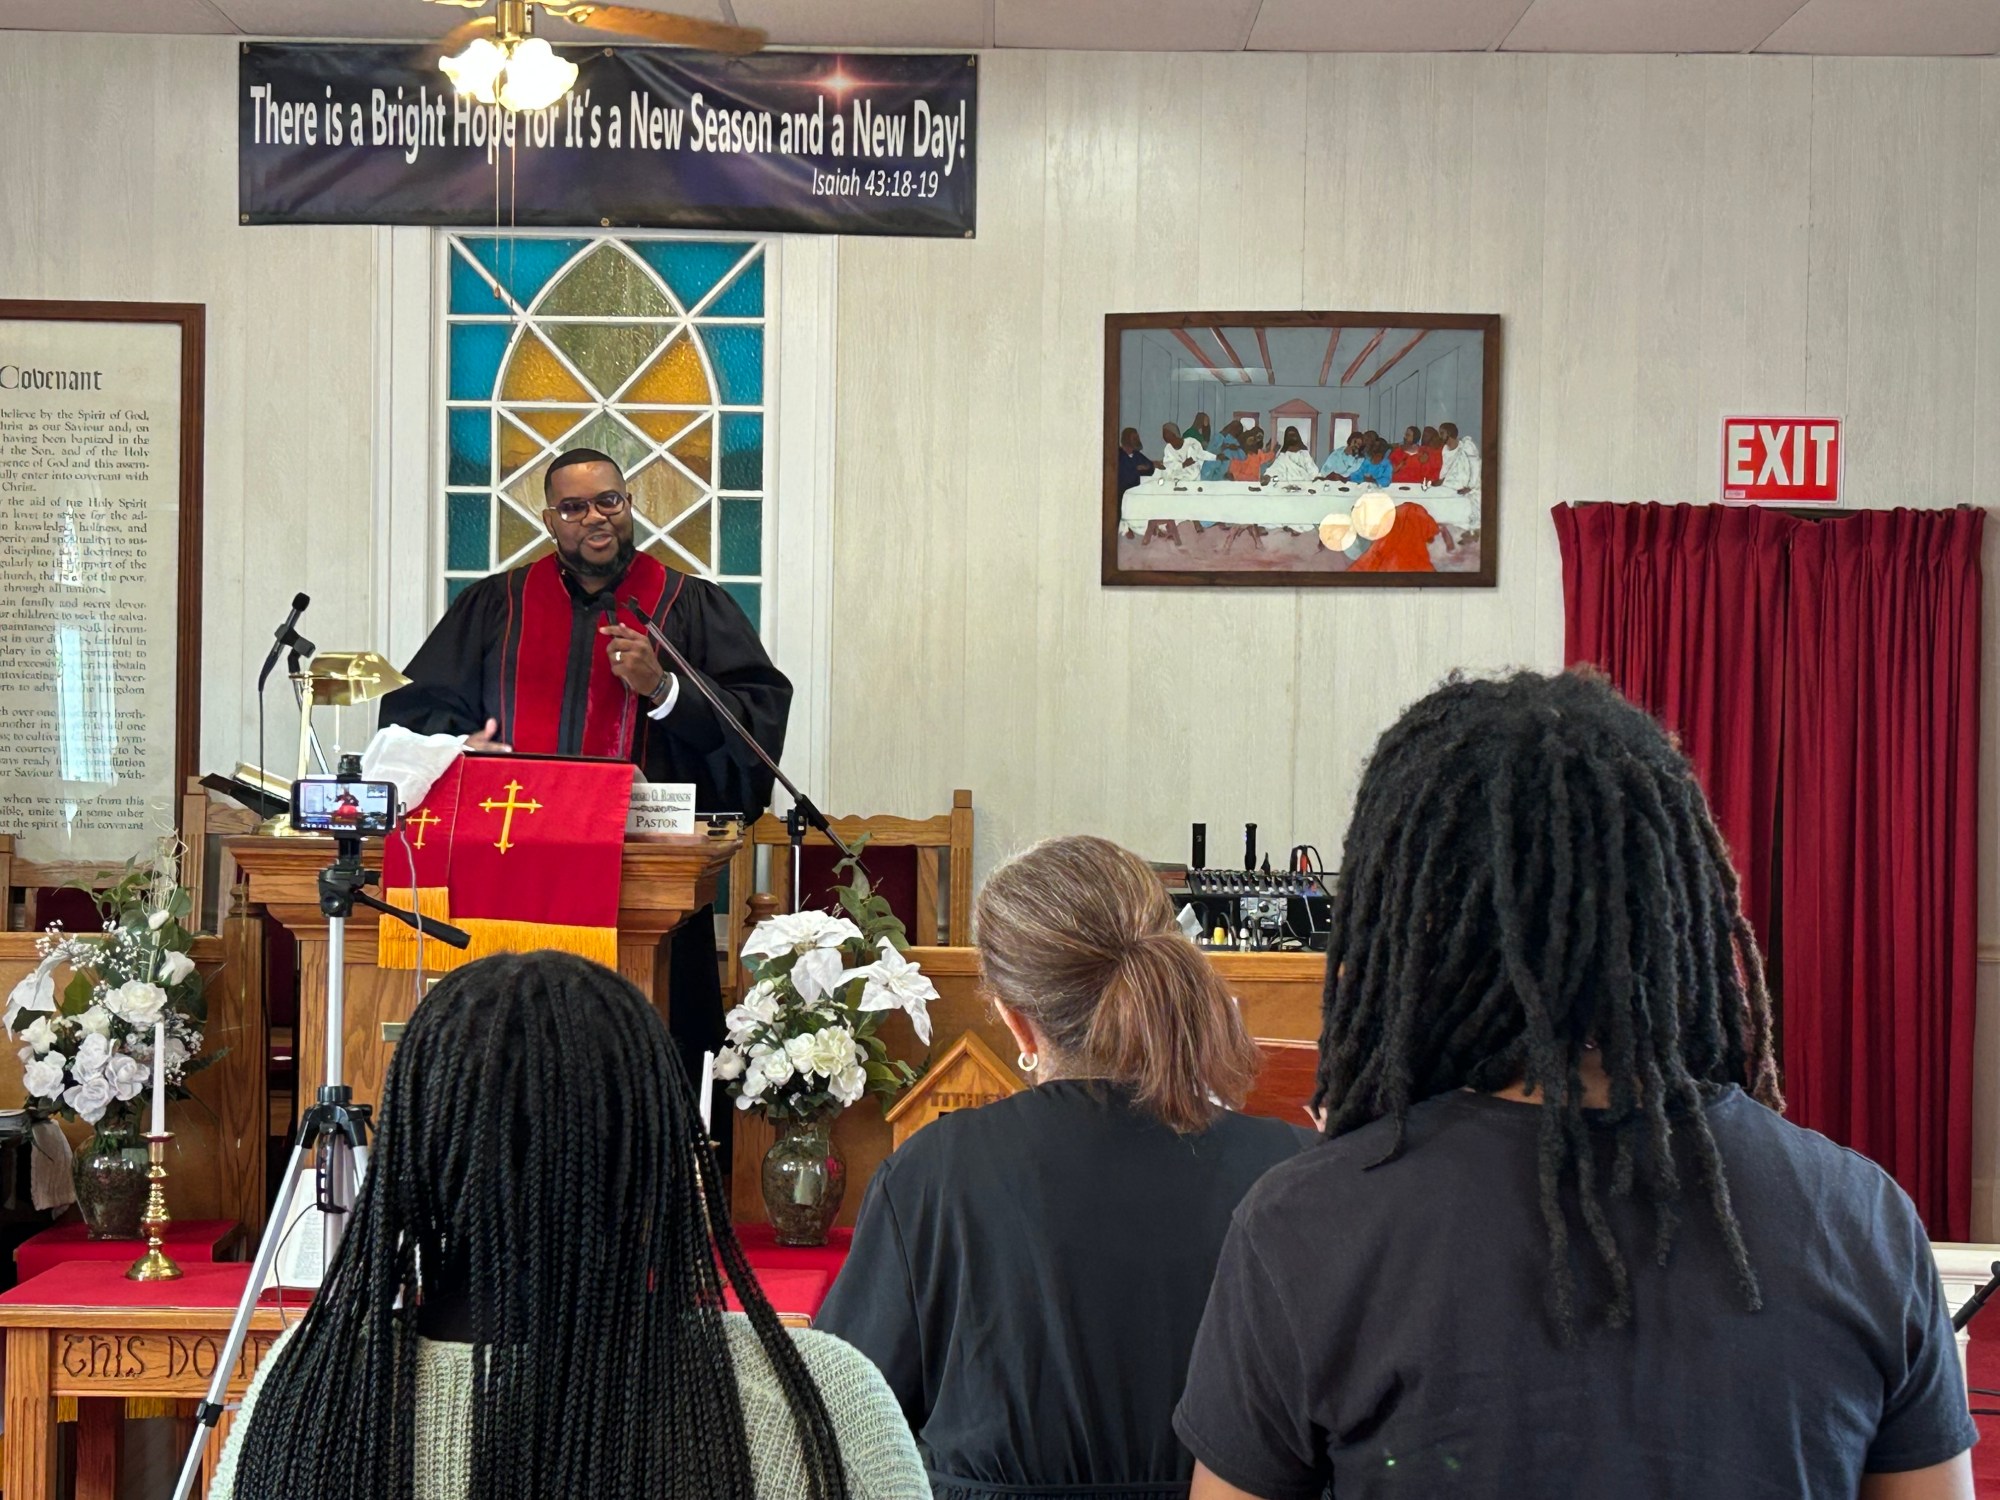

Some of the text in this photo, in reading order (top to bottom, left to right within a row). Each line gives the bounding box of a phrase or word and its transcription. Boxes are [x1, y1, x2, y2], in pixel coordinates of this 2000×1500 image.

[250, 83, 317, 145] There
[325, 85, 343, 146] is
[350, 102, 363, 146] a
[371, 86, 446, 164] Bright
[454, 91, 515, 164] Hope
[565, 89, 601, 149] It's
[608, 105, 621, 149] a
[630, 90, 683, 150] New
[690, 92, 772, 153] Season
[780, 95, 823, 156] and
[831, 113, 844, 156] a
[853, 98, 906, 157] New
[913, 99, 966, 176] Day!
[812, 168, 939, 198] Isaiah 43:18-19
[0, 365, 102, 391] Covenant
[40, 409, 51, 422] by
[57, 409, 73, 420] the
[78, 409, 105, 422] Spirit
[110, 410, 121, 420] of
[65, 421, 104, 431] Saviour
[3, 432, 149, 446] having been baptized in the
[10, 445, 27, 455] the
[61, 445, 80, 455] and
[86, 445, 97, 456] of
[102, 445, 118, 456] the
[125, 445, 149, 458] Holy
[1727, 425, 1835, 486] EXIT
[33, 457, 43, 467] of
[47, 457, 69, 468] God
[72, 457, 90, 468] and
[95, 458, 113, 468] this
[22, 471, 49, 480] enter
[52, 471, 72, 480] into
[75, 472, 121, 480] covenant
[126, 470, 149, 480] with
[8, 496, 24, 506] the
[30, 496, 45, 506] aid
[51, 496, 61, 507] of
[89, 497, 113, 510] Holy
[119, 497, 147, 510] Spirit
[43, 510, 53, 519] to
[91, 509, 106, 519] for
[111, 509, 127, 520] the
[128, 522, 147, 532] and
[31, 533, 49, 543] and
[116, 535, 126, 544] to
[137, 548, 147, 557] to
[38, 559, 48, 567] to
[116, 558, 127, 569] of
[131, 558, 147, 569] the
[4, 582, 45, 595] through
[50, 582, 61, 593] all
[22, 596, 55, 609] family
[60, 597, 78, 607] and
[62, 611, 71, 619] to
[100, 609, 115, 620] the
[12, 634, 21, 643] in
[137, 636, 147, 645] in
[20, 683, 30, 692] to
[41, 720, 50, 729] in
[14, 732, 23, 741] to
[134, 745, 146, 755] be
[24, 755, 49, 768] ready
[15, 767, 53, 777] Saviour
[4, 794, 32, 804] when
[97, 795, 121, 805] from
[126, 795, 145, 805] this
[28, 808, 54, 817] unite
[13, 817, 29, 828] the
[31, 820, 57, 831] spirit
[76, 818, 95, 829] this
[98, 821, 144, 829] covenant
[636, 815, 678, 828] PASTOR
[166, 1335, 220, 1380] DO
